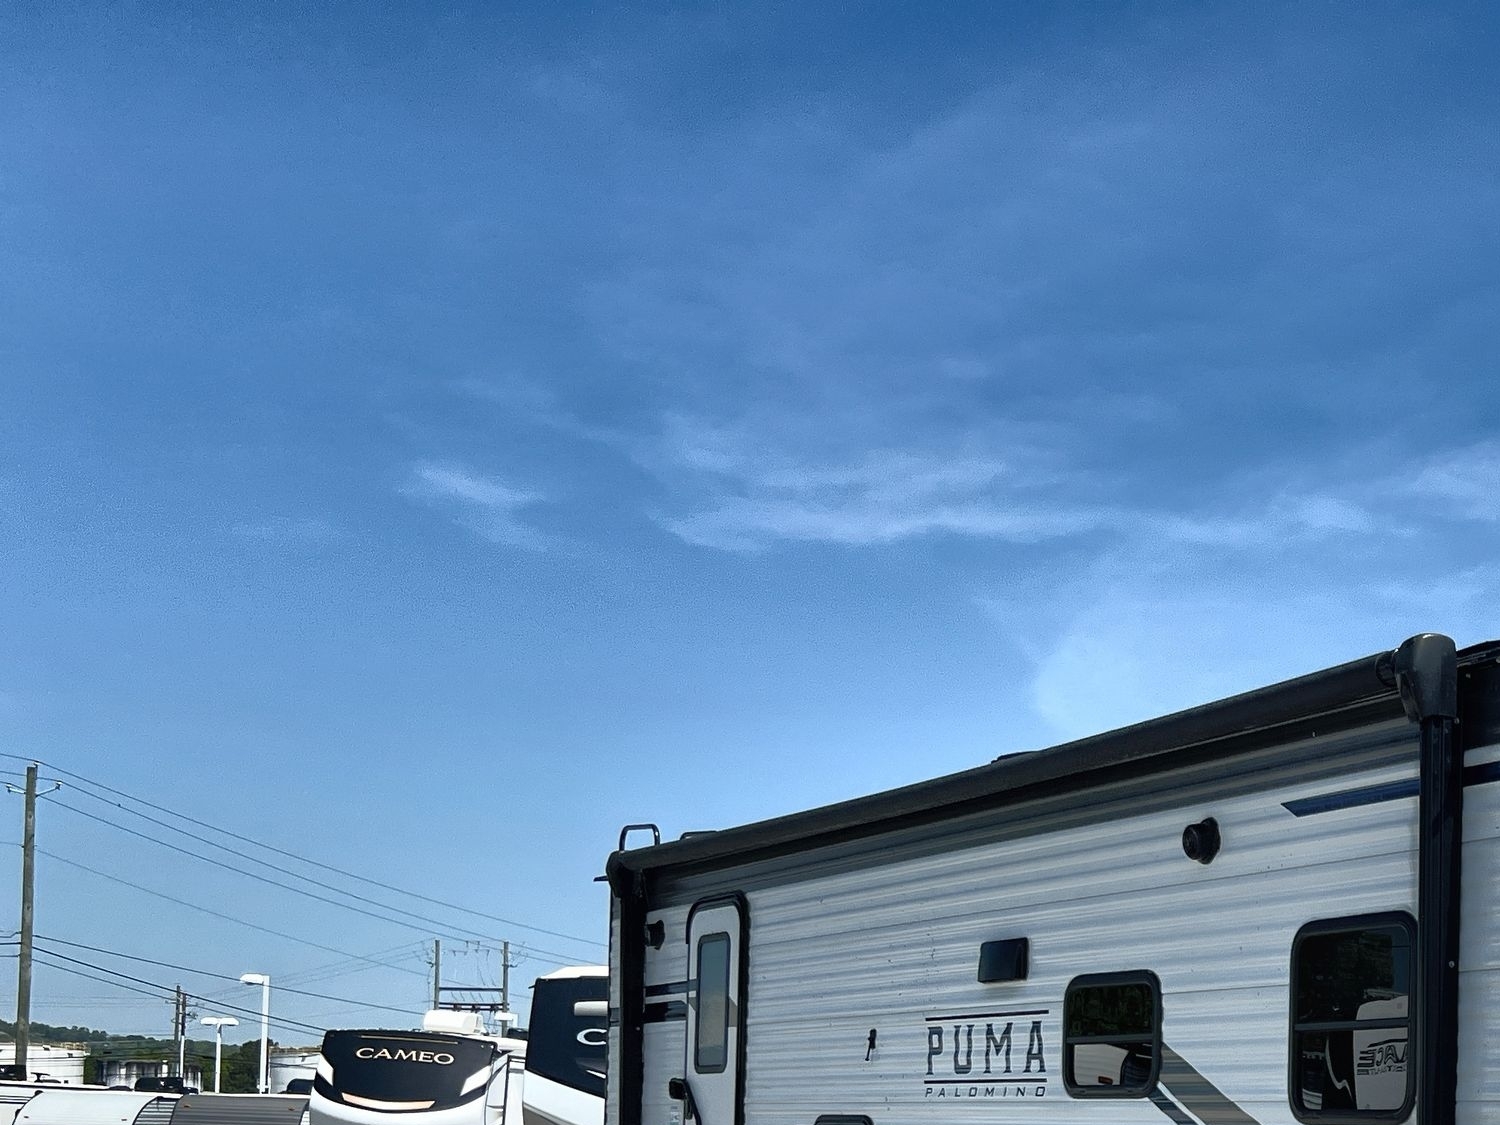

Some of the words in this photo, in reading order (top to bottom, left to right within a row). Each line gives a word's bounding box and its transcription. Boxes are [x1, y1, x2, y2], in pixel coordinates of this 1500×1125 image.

[355, 1047, 455, 1065] CAMEO
[925, 1020, 1047, 1076] PUMA
[924, 1086, 1047, 1098] PALOMINO
